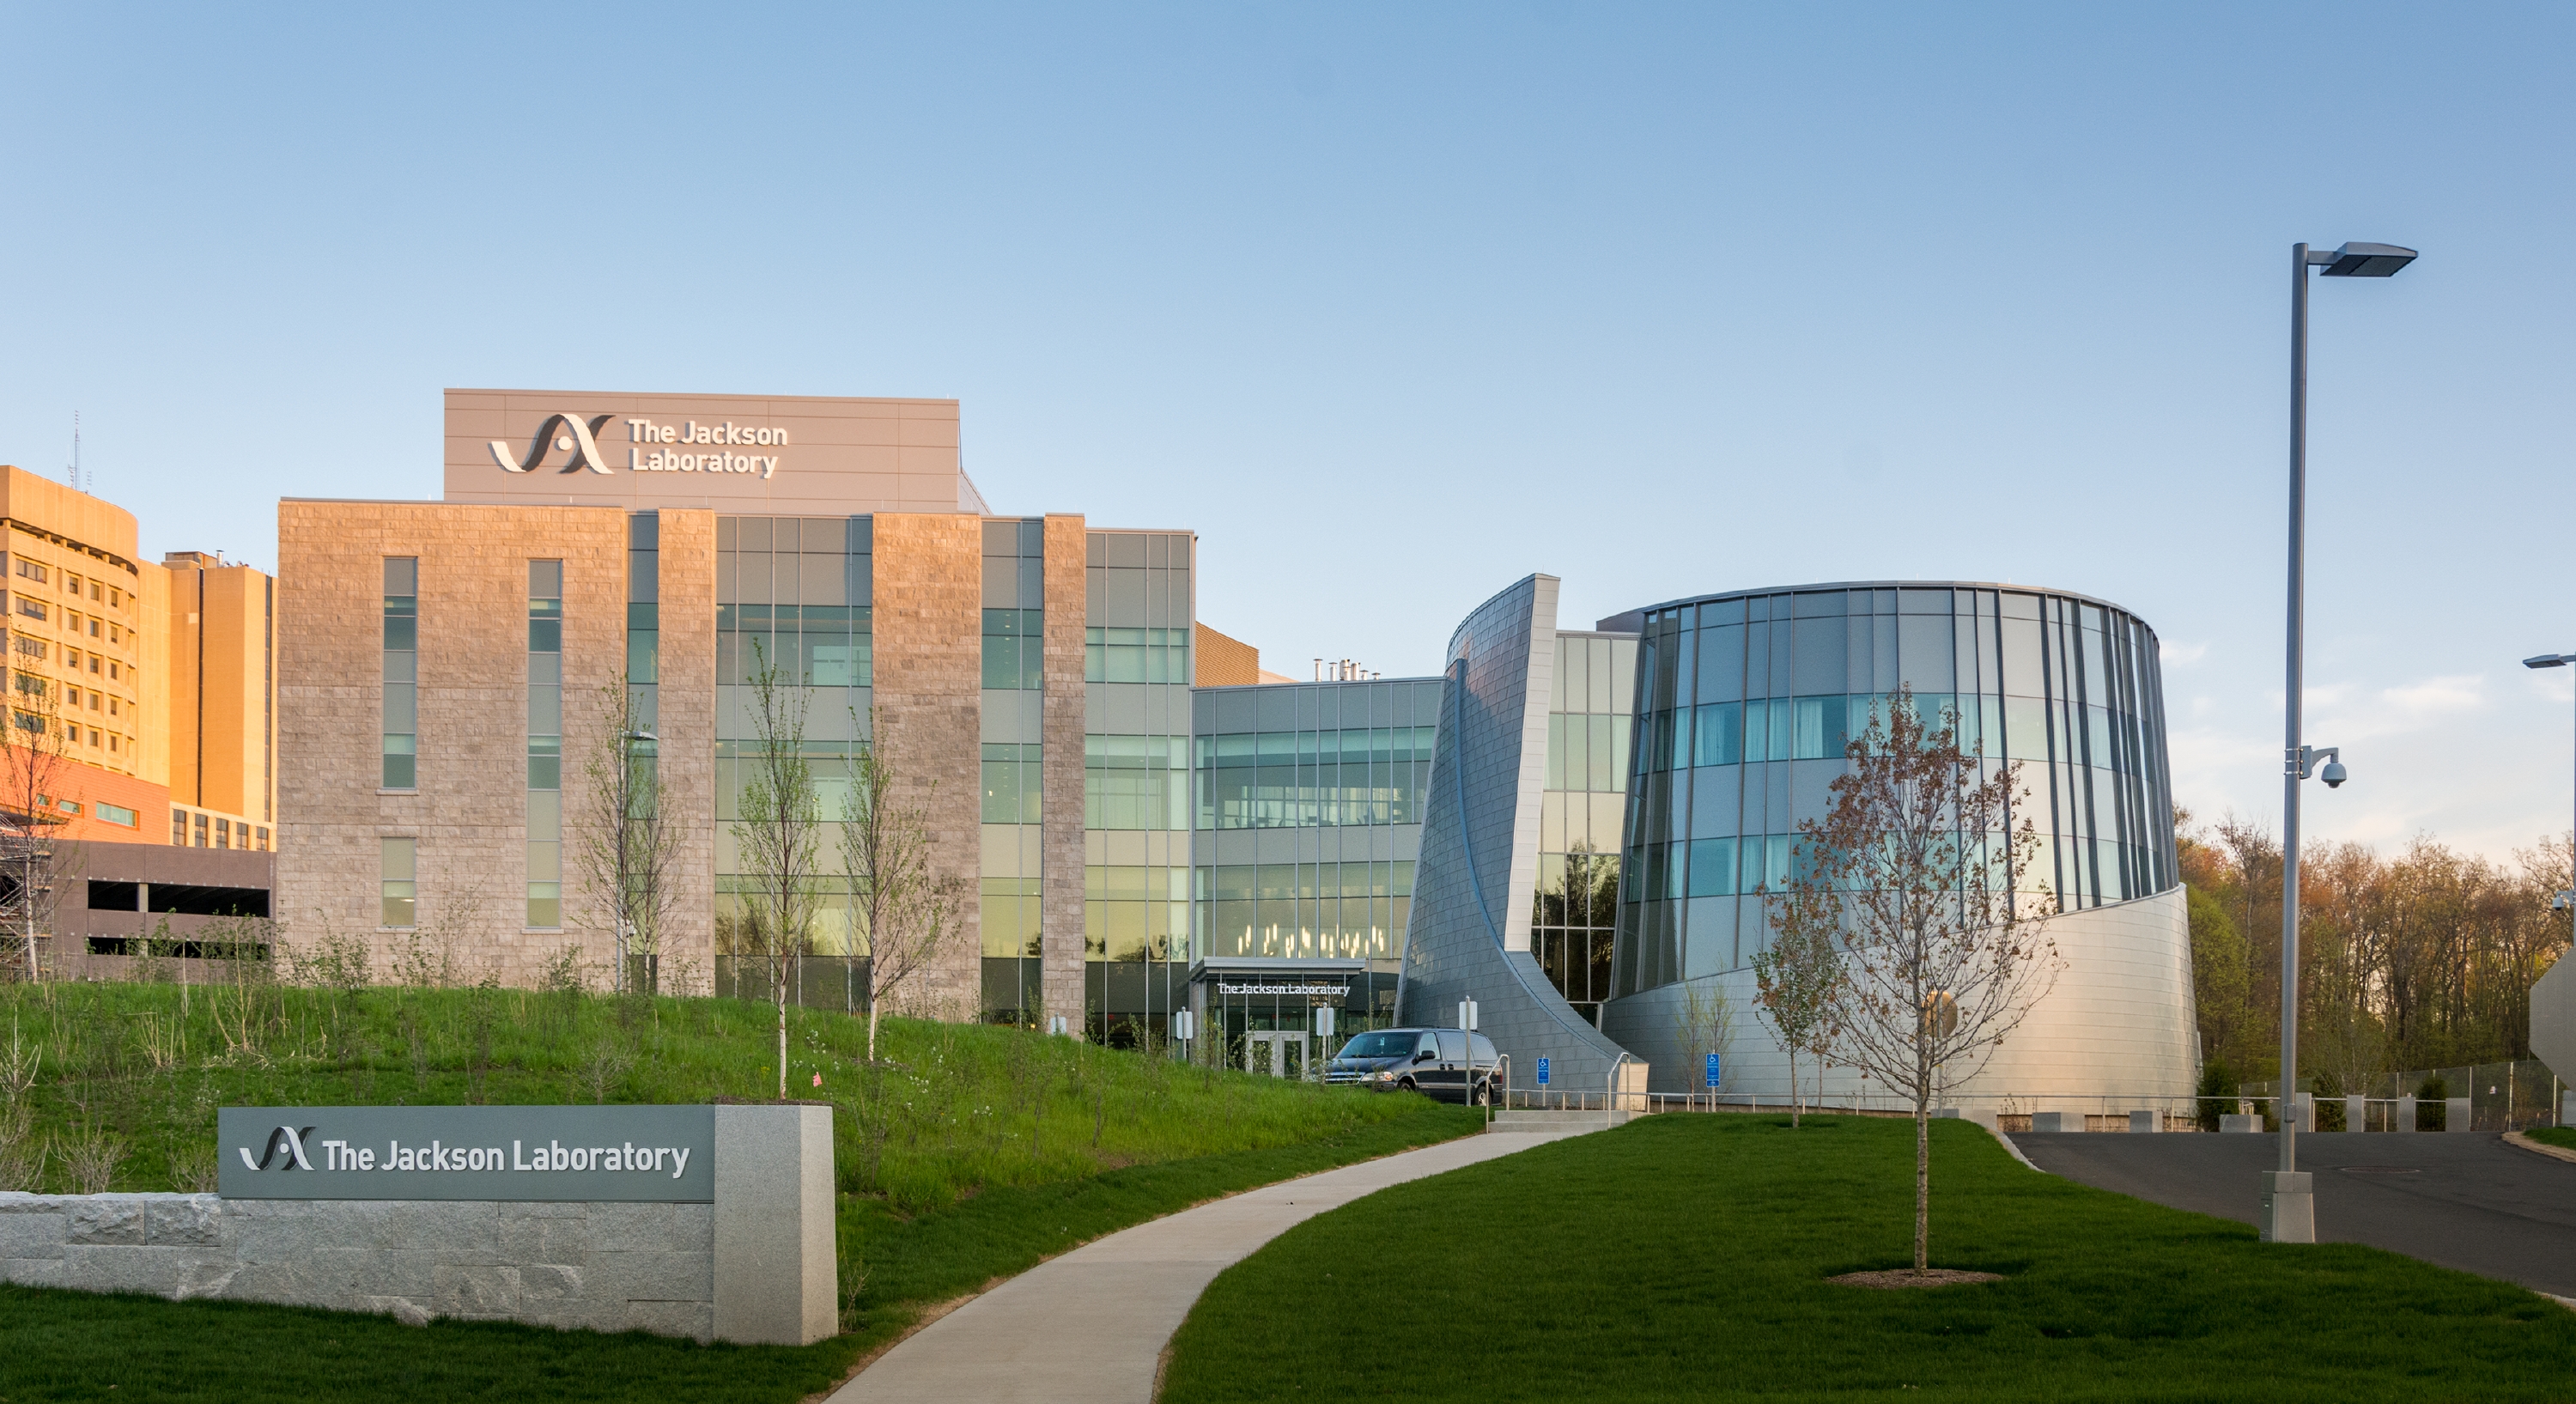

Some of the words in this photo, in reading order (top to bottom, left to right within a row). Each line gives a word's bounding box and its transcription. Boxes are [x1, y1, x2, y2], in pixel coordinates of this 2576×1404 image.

[628, 418, 677, 444] The
[681, 420, 787, 446] Jackson
[632, 447, 779, 479] Laboratory
[1217, 982, 1238, 994] The
[1239, 983, 1286, 994] Jackson
[1288, 983, 1351, 997] Laboratory
[322, 1140, 376, 1172] The
[380, 1140, 505, 1172] Jackson
[513, 1140, 691, 1179] Laboratory
